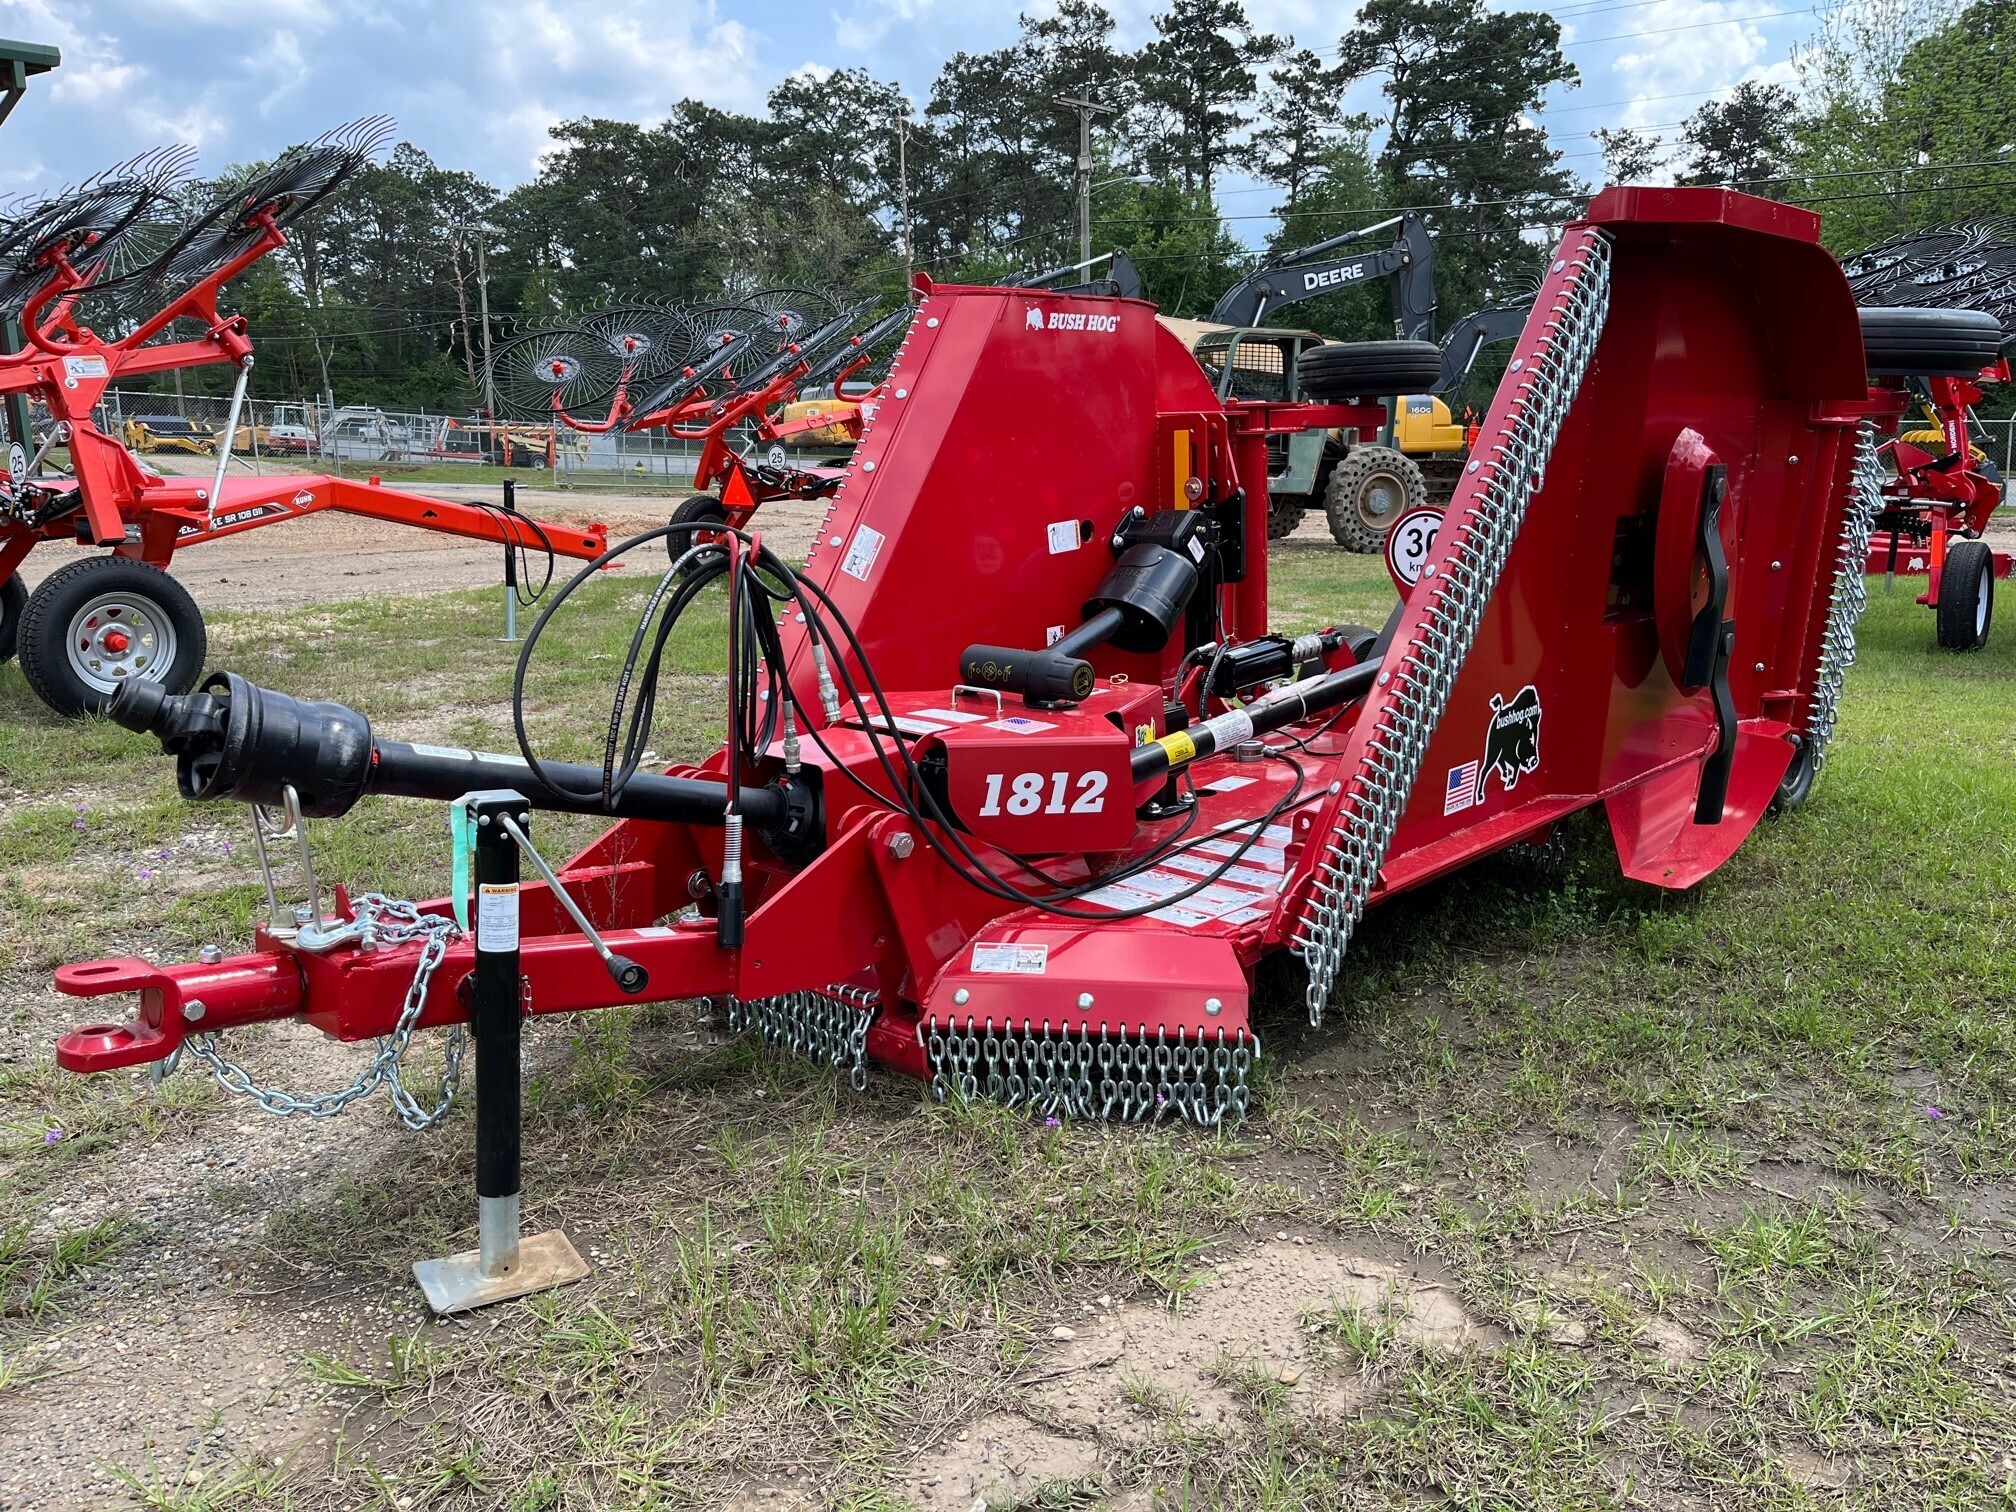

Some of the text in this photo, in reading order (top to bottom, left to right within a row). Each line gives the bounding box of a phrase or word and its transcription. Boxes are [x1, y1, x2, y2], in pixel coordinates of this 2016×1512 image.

[1304, 263, 1364, 290] DEERE
[1047, 313, 1086, 330] BUSH
[12, 455, 24, 474] 25
[771, 453, 783, 463] 25
[225, 513, 237, 524] SR
[238, 510, 252, 521] 108
[617, 686, 626, 700] BAR
[1496, 704, 1538, 729] bushhog.com
[979, 770, 1108, 816] 1812
